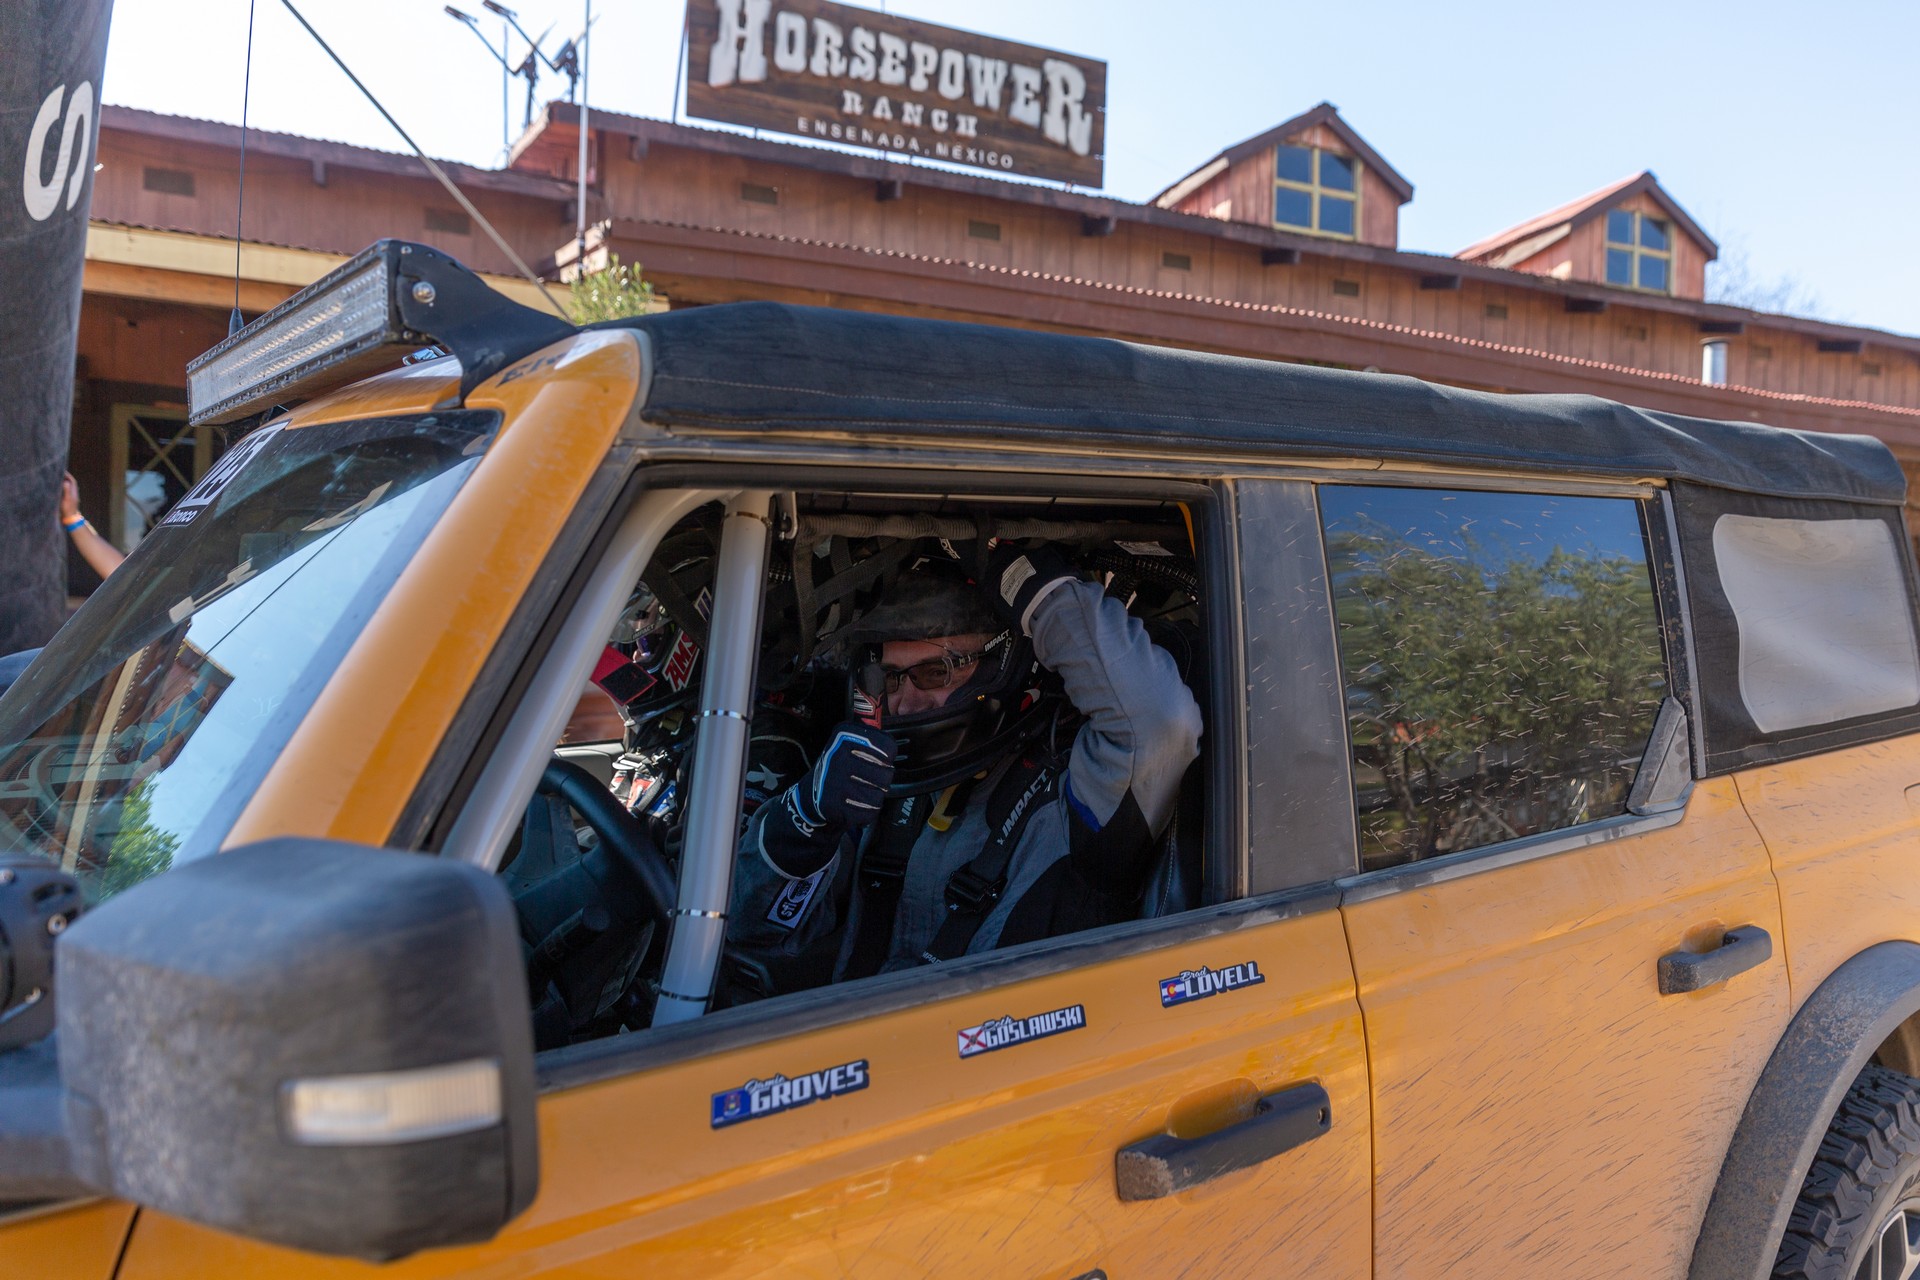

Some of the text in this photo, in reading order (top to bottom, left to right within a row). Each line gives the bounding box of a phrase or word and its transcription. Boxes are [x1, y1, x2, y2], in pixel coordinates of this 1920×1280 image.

[709, 0, 1092, 157] HORSEPOWER
[841, 89, 979, 138] RANCH
[984, 628, 1011, 653] IMPACT
[1003, 768, 1048, 838] IMPACT
[1184, 962, 1261, 998] LOVELL
[985, 1005, 1083, 1048] GOSLAWSKI
[751, 1060, 865, 1115] GROVES
